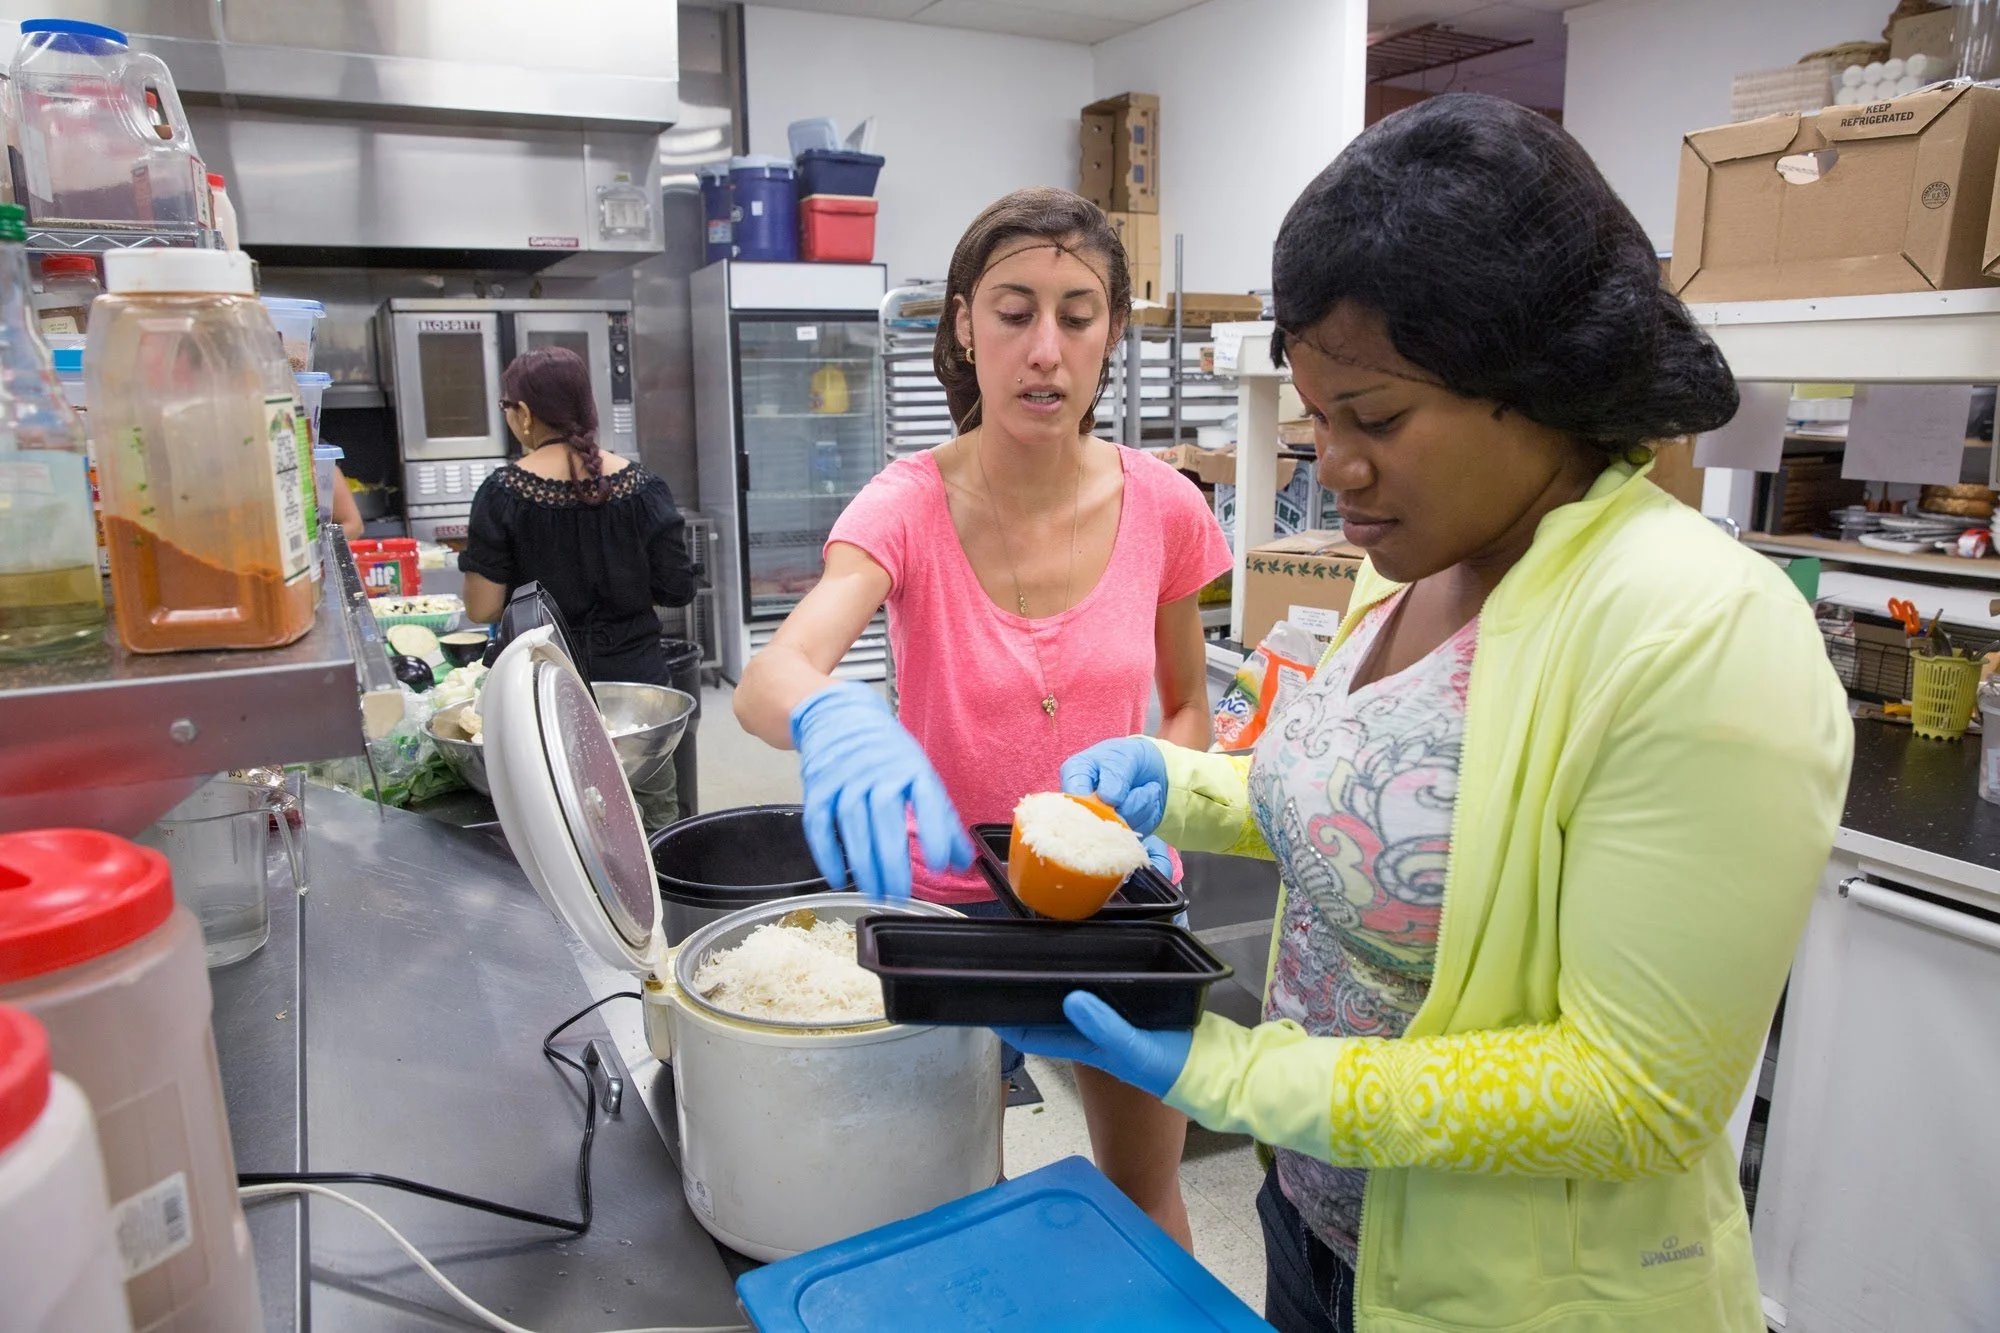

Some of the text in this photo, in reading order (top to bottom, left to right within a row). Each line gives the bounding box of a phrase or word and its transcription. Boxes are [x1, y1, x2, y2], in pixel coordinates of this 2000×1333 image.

[1865, 103, 1892, 115] KEEP
[1840, 111, 1915, 127] REFRIGERATED
[416, 319, 482, 331] BLODGETT
[364, 565, 396, 588] Jif
[1639, 1241, 1705, 1268] SPALDING
